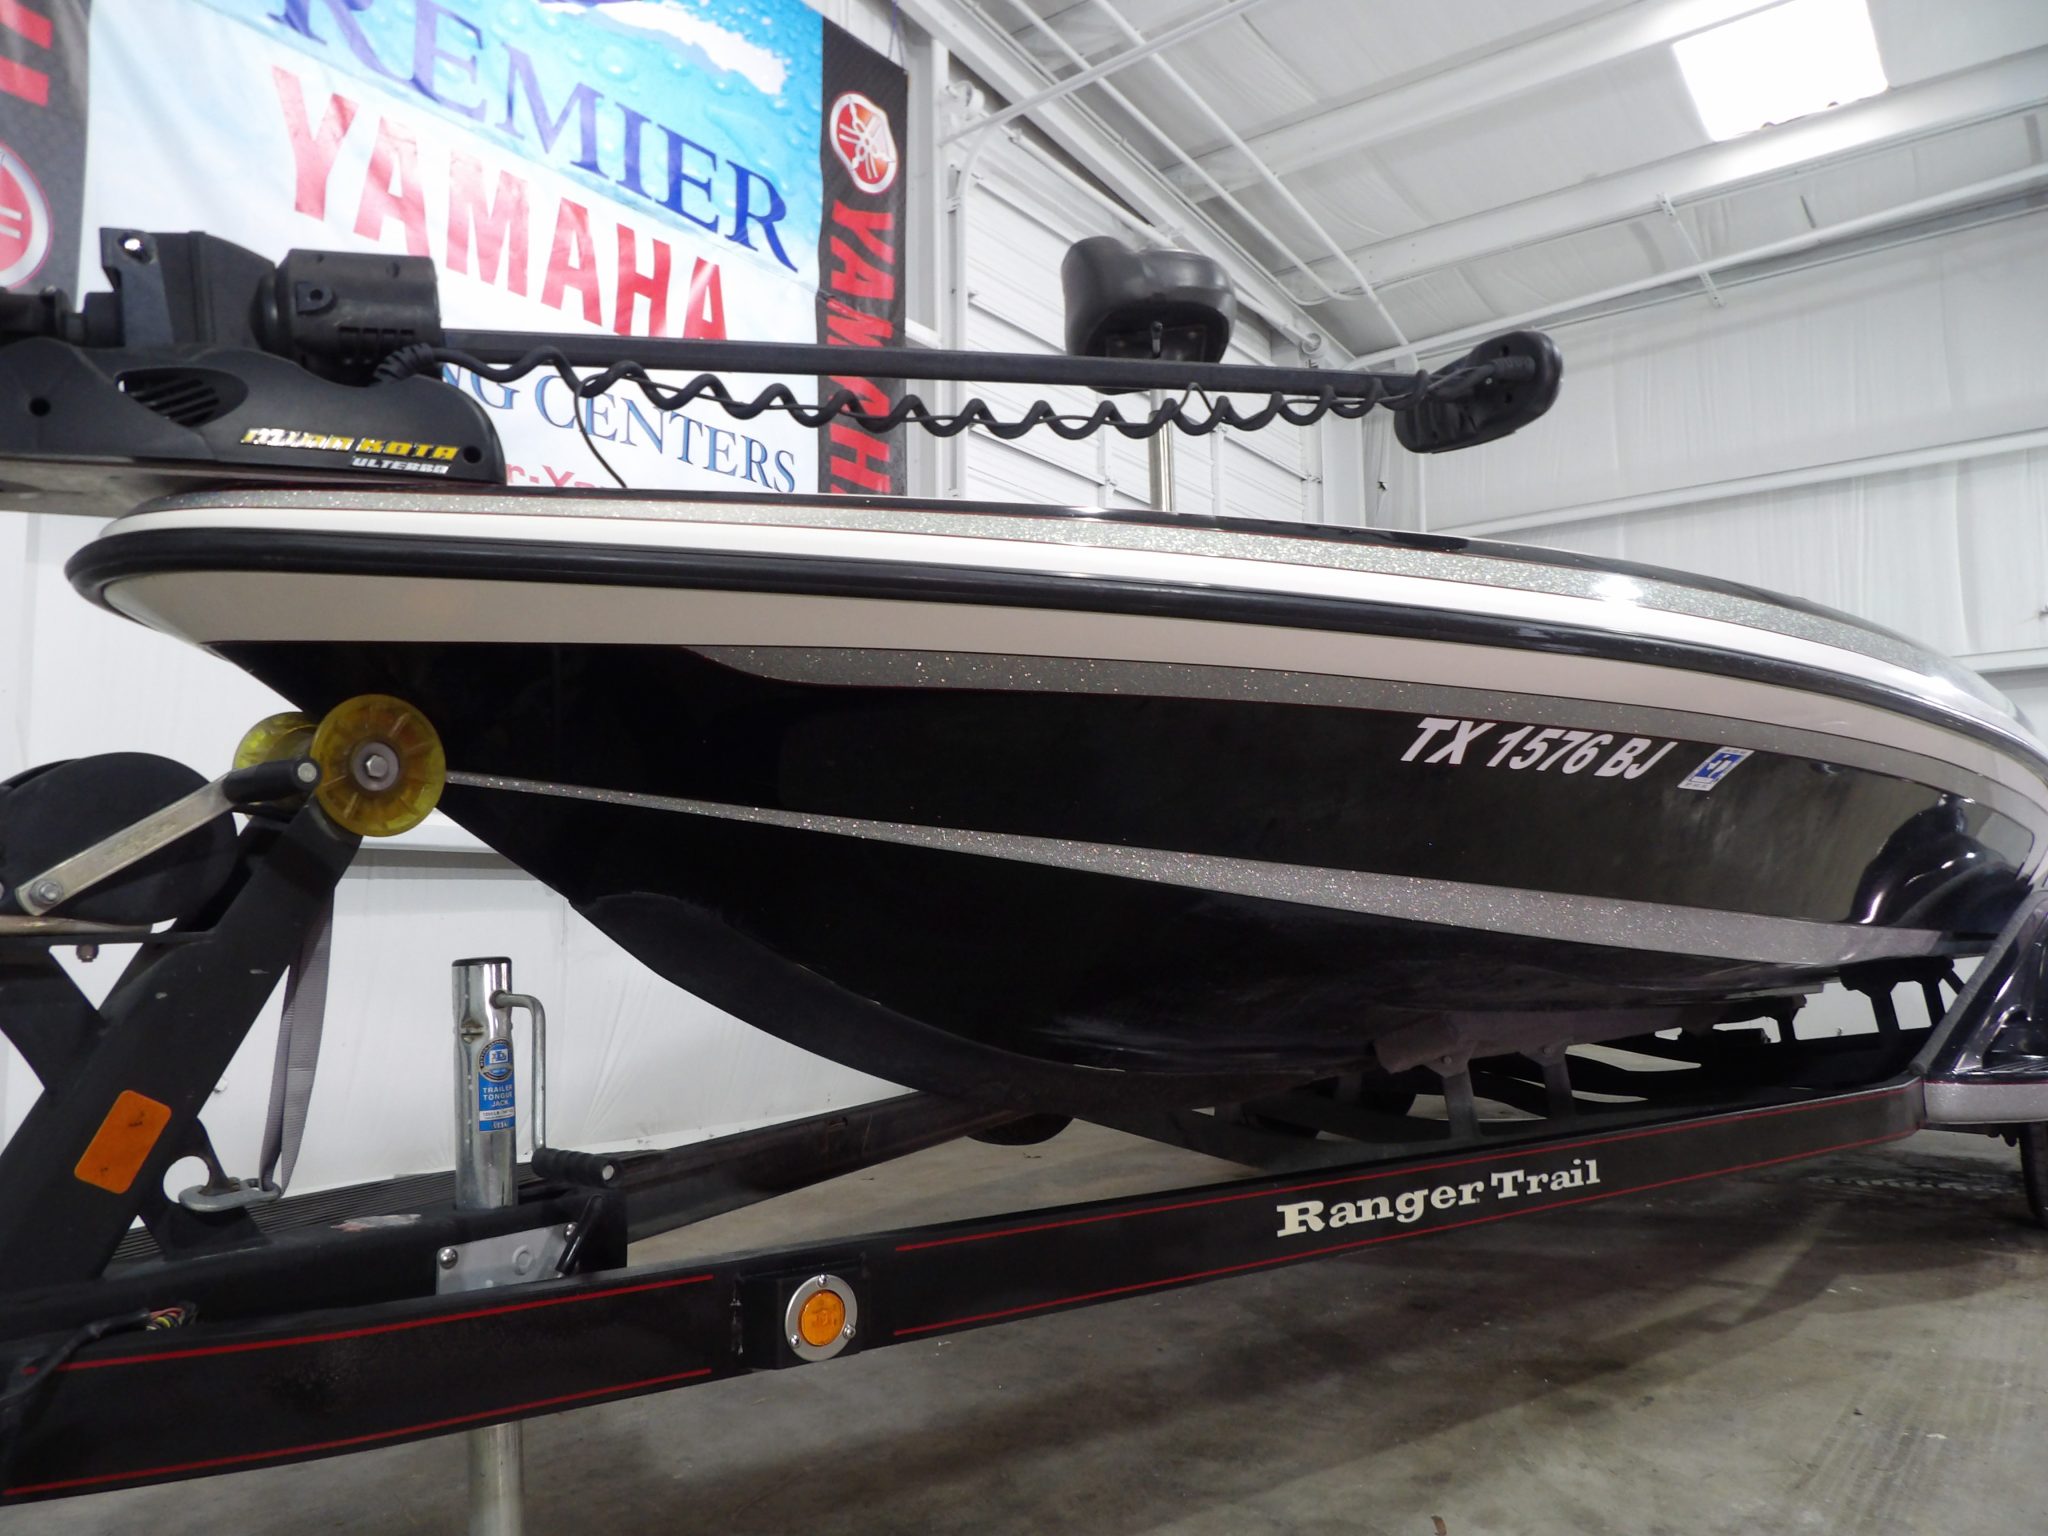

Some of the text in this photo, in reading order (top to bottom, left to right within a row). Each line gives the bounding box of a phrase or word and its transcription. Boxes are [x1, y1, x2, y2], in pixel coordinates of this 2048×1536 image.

[271, 65, 728, 341] YAMAHA
[355, 438, 459, 460] KOTA
[534, 374, 796, 493] CENTERS
[1400, 717, 1497, 765] TX
[1487, 725, 1614, 774] 1576
[1594, 737, 1678, 780] BJ
[482, 1084, 513, 1094] TRAILER
[483, 1092, 513, 1101] TONGUE
